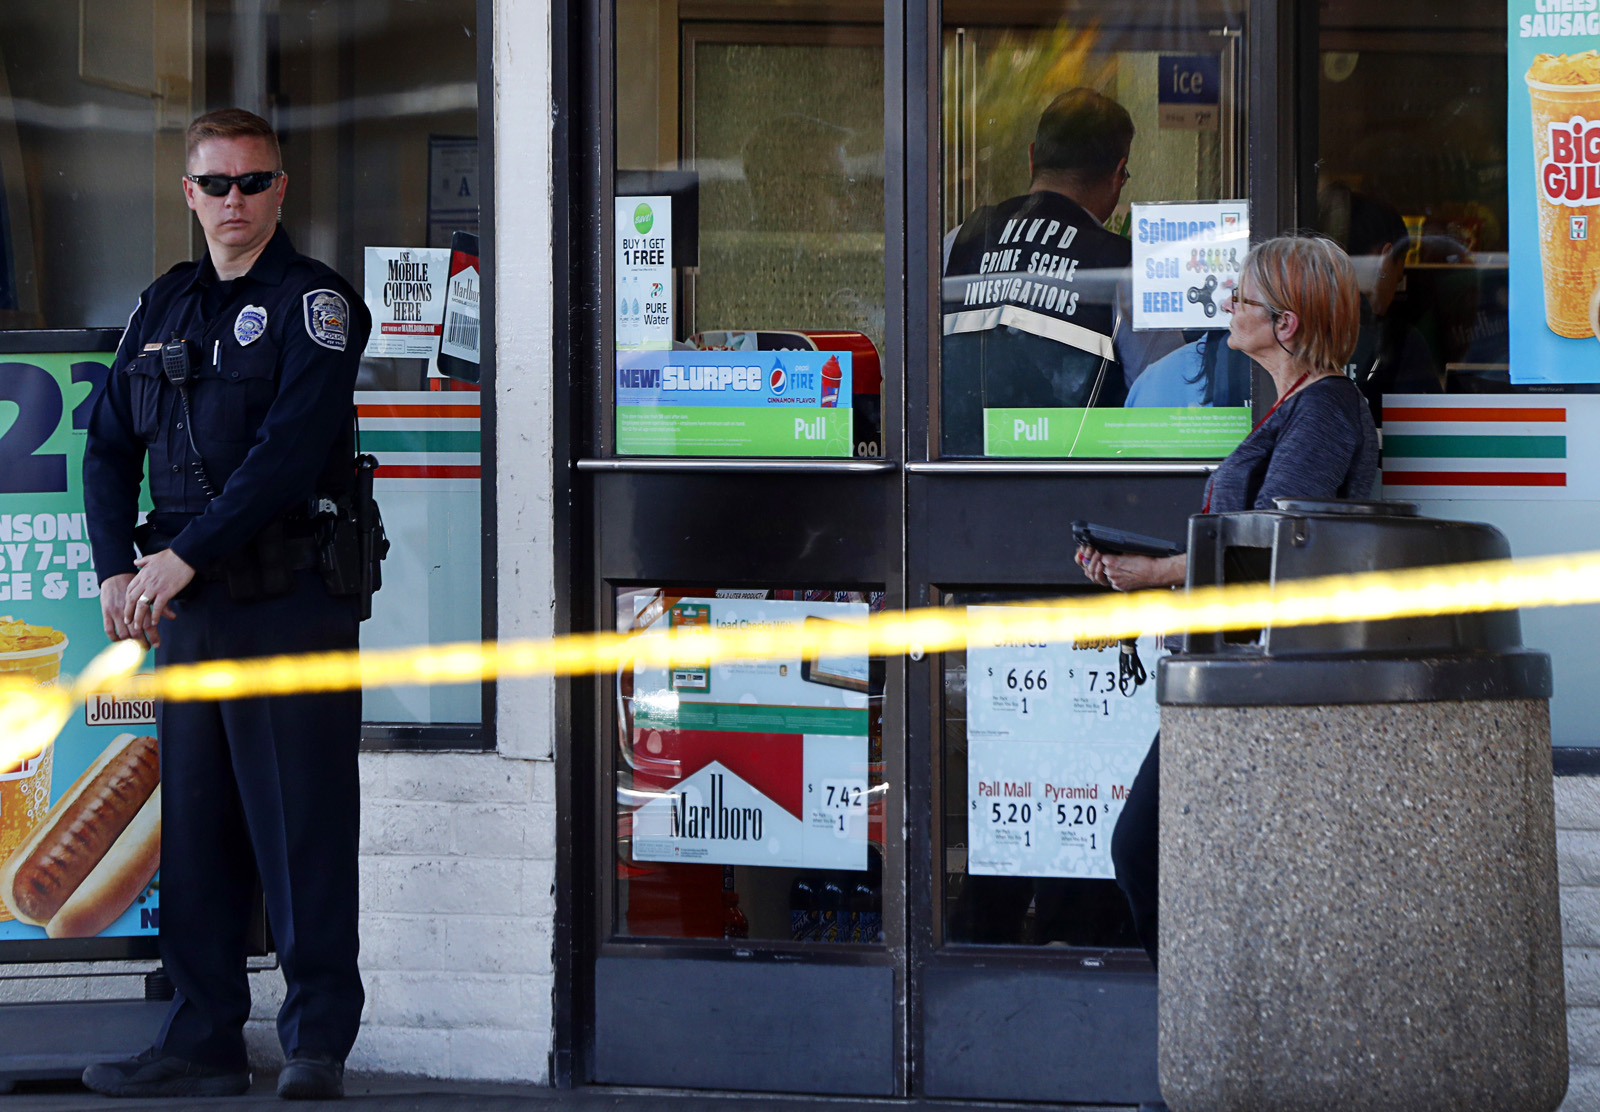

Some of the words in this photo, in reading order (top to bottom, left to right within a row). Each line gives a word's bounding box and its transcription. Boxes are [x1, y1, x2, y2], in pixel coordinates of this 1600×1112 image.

[1520, 12, 1600, 38] SAUSAG
[1173, 65, 1203, 93] ice
[1544, 163, 1600, 201] GUL
[998, 218, 1078, 249] NLVPD
[1138, 218, 1216, 244] Spinners
[622, 238, 640, 249] BUY
[642, 238, 647, 249] 1
[649, 238, 665, 249] GET
[400, 252, 410, 262] USE
[623, 250, 630, 265] 1
[633, 250, 665, 265] FREE
[980, 249, 1022, 275] CRIME
[1027, 251, 1079, 282] SCENE
[388, 260, 429, 281] MOBILE
[1145, 258, 1180, 279] Sold
[384, 282, 432, 307] COUPONS
[964, 278, 1080, 316] INVESTIGATIONS
[1143, 291, 1184, 313] HERE!
[393, 302, 422, 321] HERE
[645, 303, 667, 314] PURE
[643, 315, 669, 325] Water
[620, 369, 660, 389] NEW!
[790, 373, 814, 390] FIRE
[794, 416, 826, 440] Pull
[1014, 417, 1049, 441] Pull
[35, 542, 95, 571] 7-P
[41, 572, 70, 600] &
[716, 618, 738, 630] Load
[988, 667, 993, 677] $
[1006, 668, 1048, 692] 6.66
[1069, 669, 1074, 678] $
[1021, 697, 1028, 713] 1
[1102, 699, 1109, 715] 1
[808, 783, 813, 793] $
[826, 786, 863, 808] 7.42
[979, 781, 1000, 797] Pall
[1004, 782, 1032, 798] Mall
[1045, 783, 1099, 803] Pyramid
[669, 773, 763, 841] Marlboro
[971, 800, 977, 810] $
[992, 802, 1031, 825] 5.20
[1037, 802, 1042, 812] $
[1057, 804, 1097, 827] 5.20
[1104, 803, 1109, 813] $
[838, 815, 844, 831] 1
[1024, 831, 1031, 847] 1
[1090, 833, 1097, 850] 1
